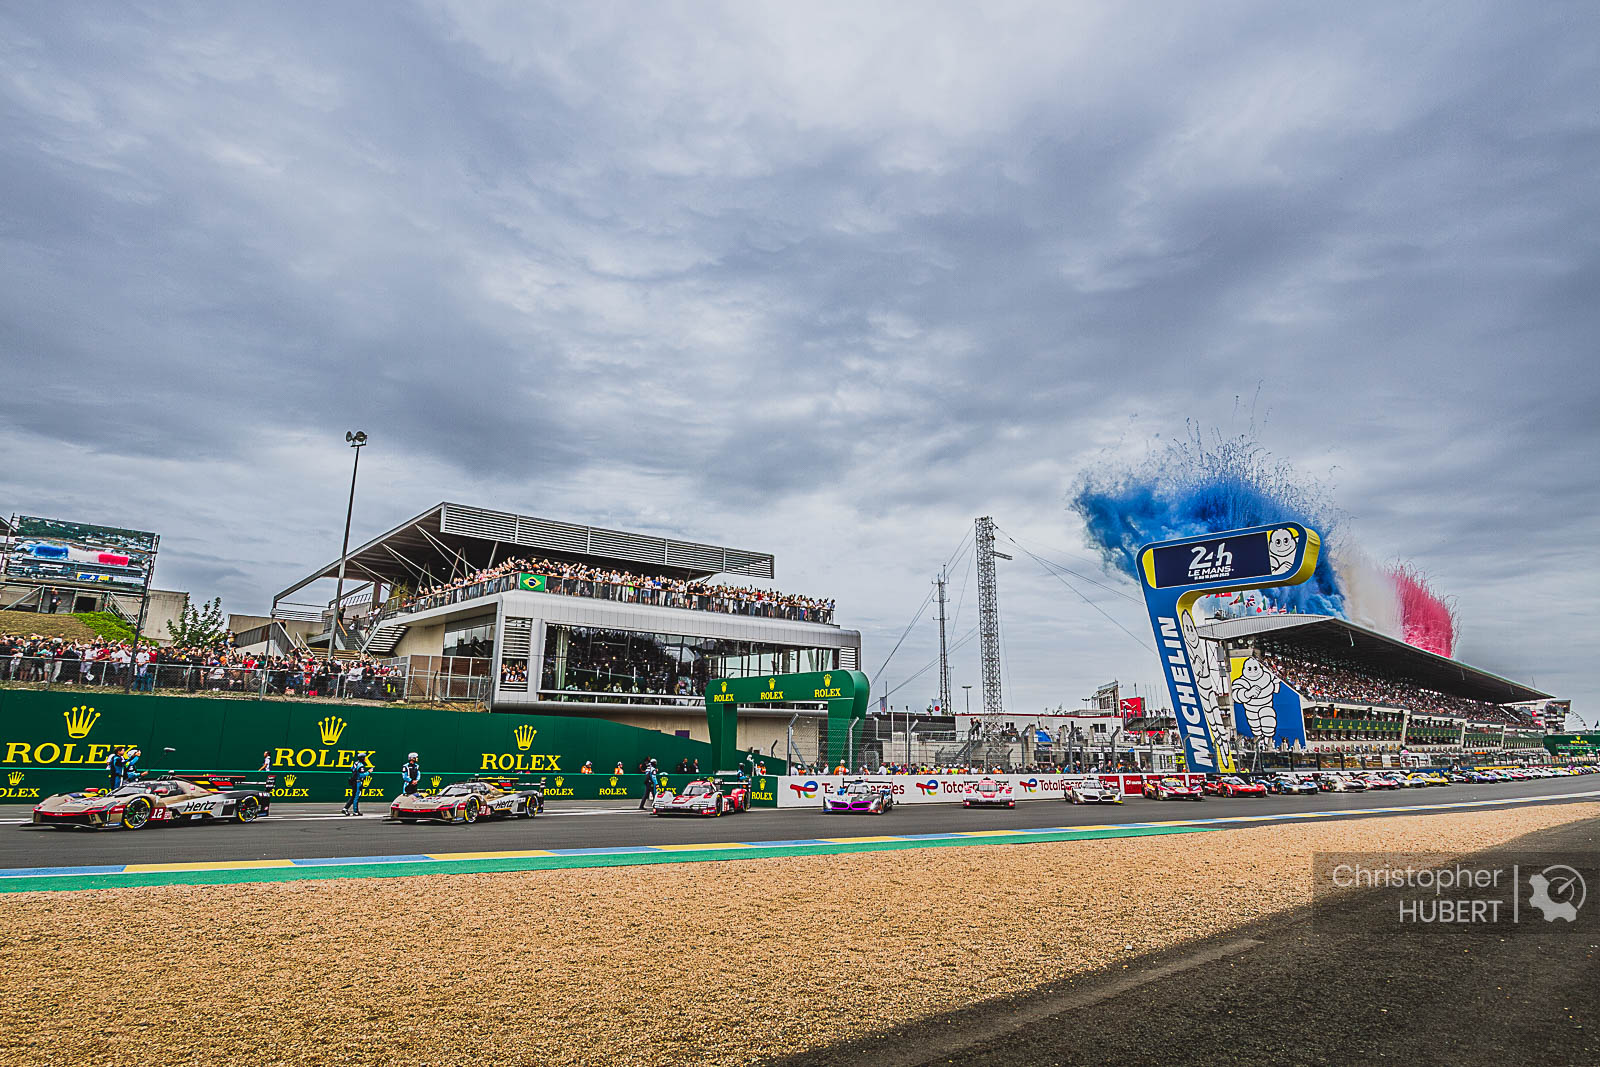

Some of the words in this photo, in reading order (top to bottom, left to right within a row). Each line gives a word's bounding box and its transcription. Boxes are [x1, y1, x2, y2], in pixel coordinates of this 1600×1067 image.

[760, 691, 783, 700] ROLEX
[813, 688, 841, 698] ROLEX
[1158, 617, 1214, 768] MICHELIN
[713, 694, 734, 702] ROLEX
[272, 748, 376, 768] ROLEX
[480, 753, 561, 771] ROLEX
[0, 787, 40, 797] OLEX
[344, 788, 385, 797] RLEX
[543, 788, 574, 796] ROLEX
[599, 787, 627, 796] ROLEX
[751, 791, 773, 801] ROLEX
[184, 801, 216, 812] Hertz
[151, 809, 163, 819] 12
